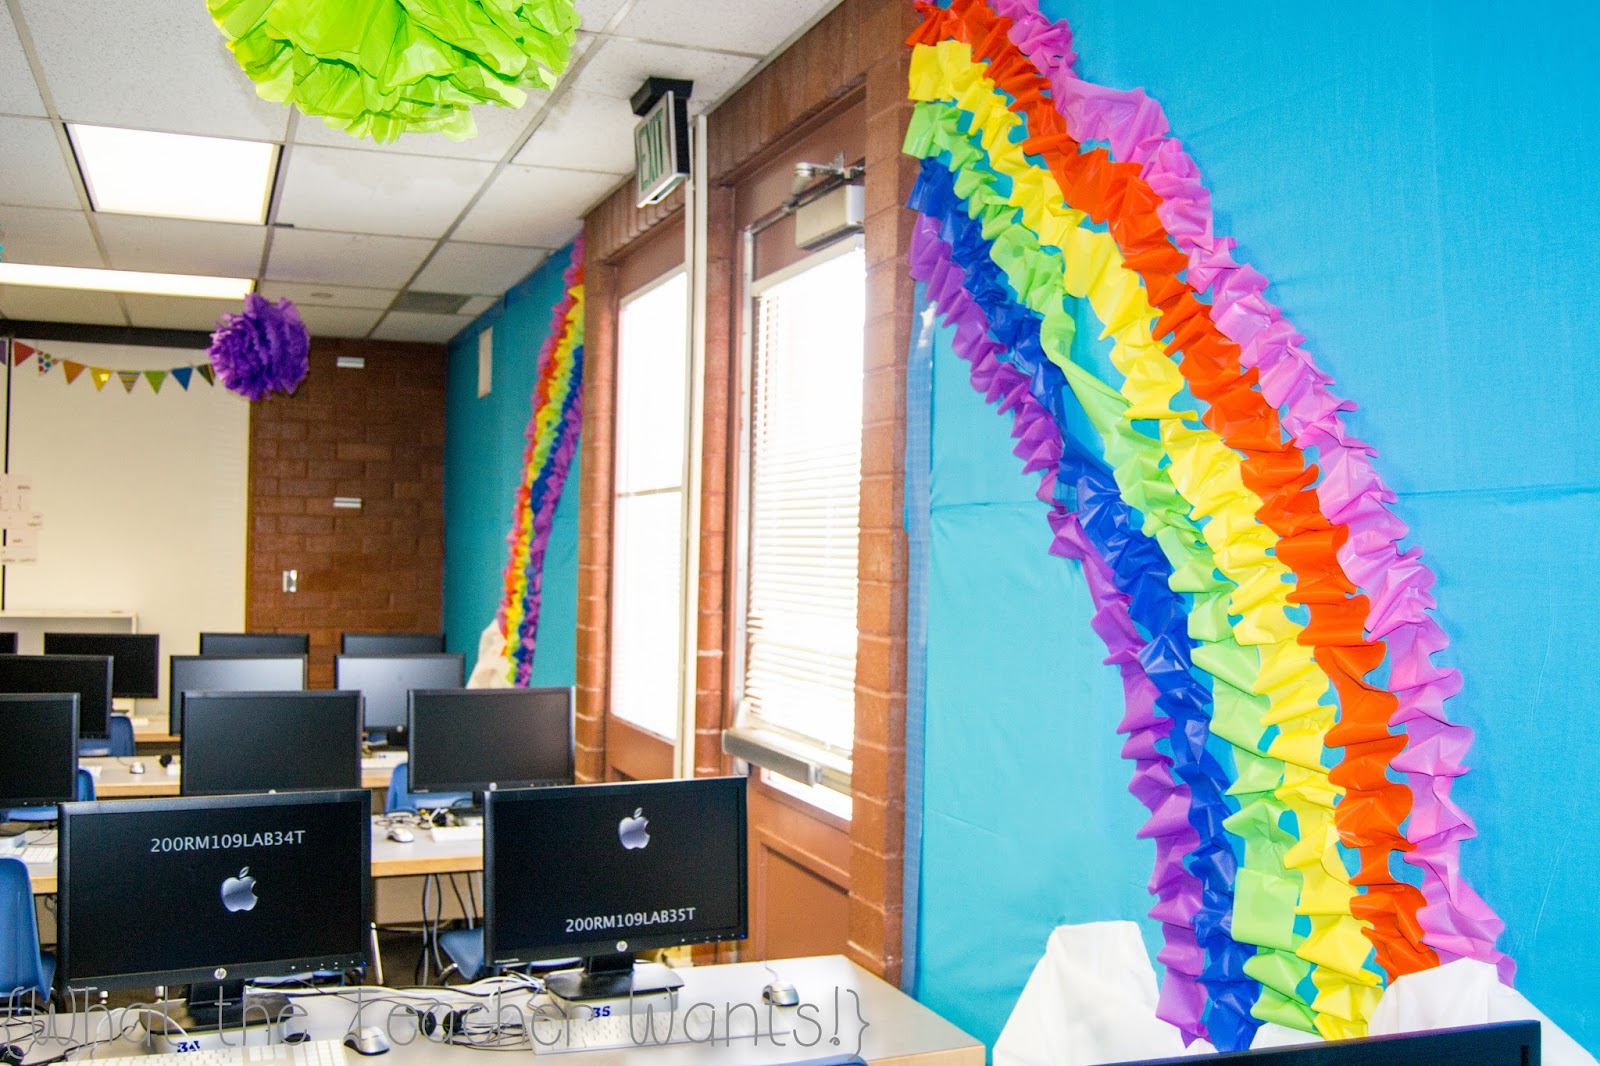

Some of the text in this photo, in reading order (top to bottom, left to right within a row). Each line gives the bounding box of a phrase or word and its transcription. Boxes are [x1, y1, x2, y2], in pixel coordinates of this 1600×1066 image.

[639, 107, 663, 192] EXIT
[150, 830, 306, 853] 200RM109LAB34T
[565, 907, 696, 933] 200RM109LAB35T
[592, 1005, 611, 1018] 35
